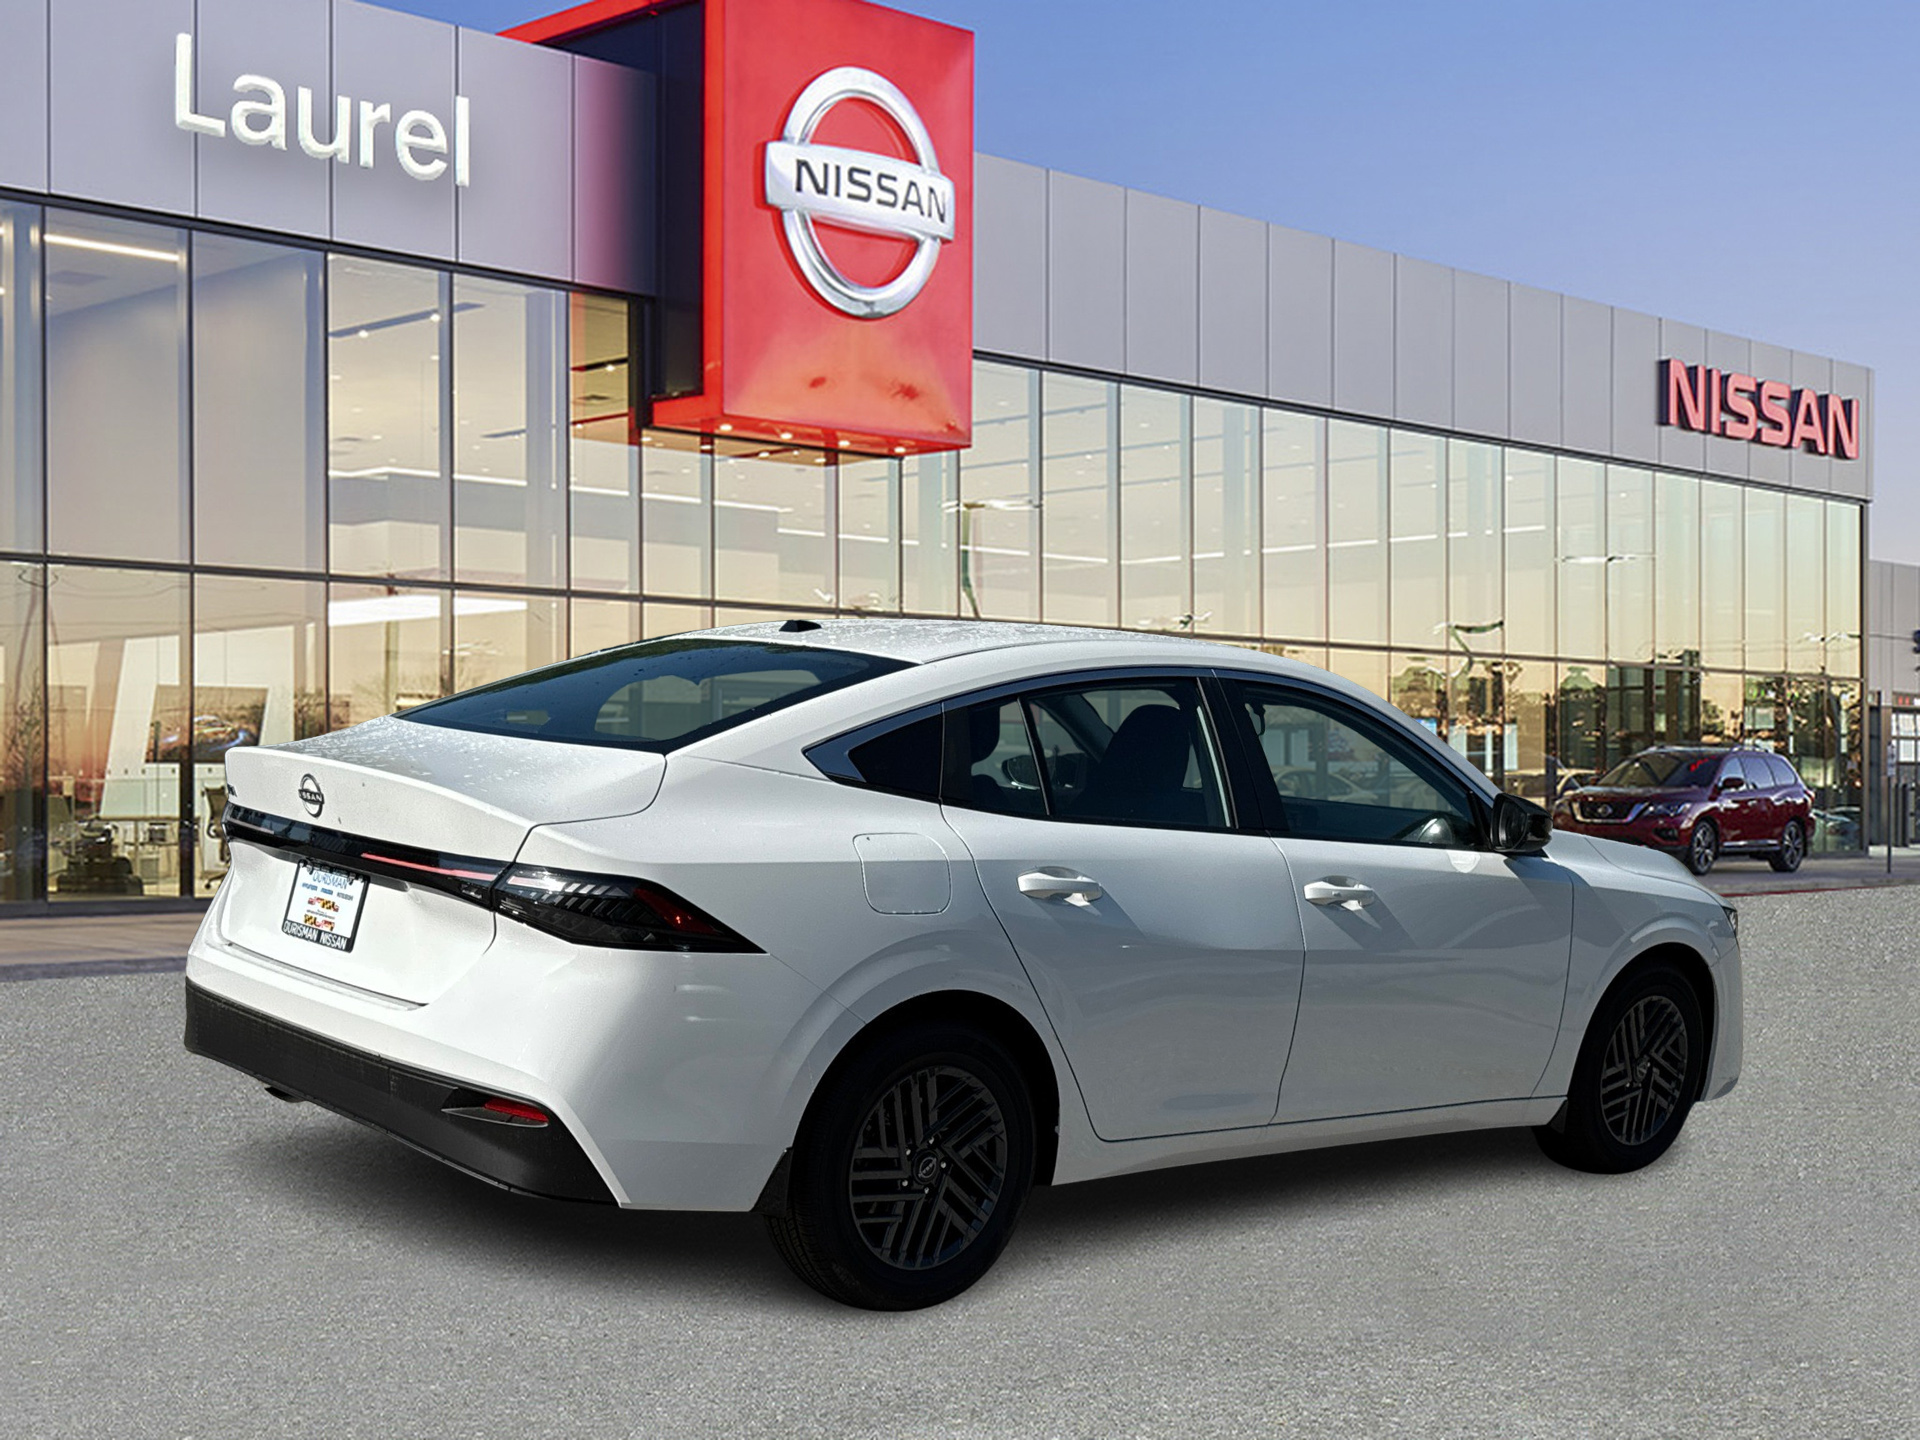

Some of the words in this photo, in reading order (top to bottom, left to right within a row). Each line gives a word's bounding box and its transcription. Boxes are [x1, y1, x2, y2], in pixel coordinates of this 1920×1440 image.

[174, 33, 470, 187] Laurel
[794, 158, 947, 223] NISSAN
[1659, 358, 1860, 459] NISSAN
[313, 871, 348, 890] OURISMAN
[283, 920, 319, 942] OURISMAN
[319, 931, 348, 950] NISSAN
